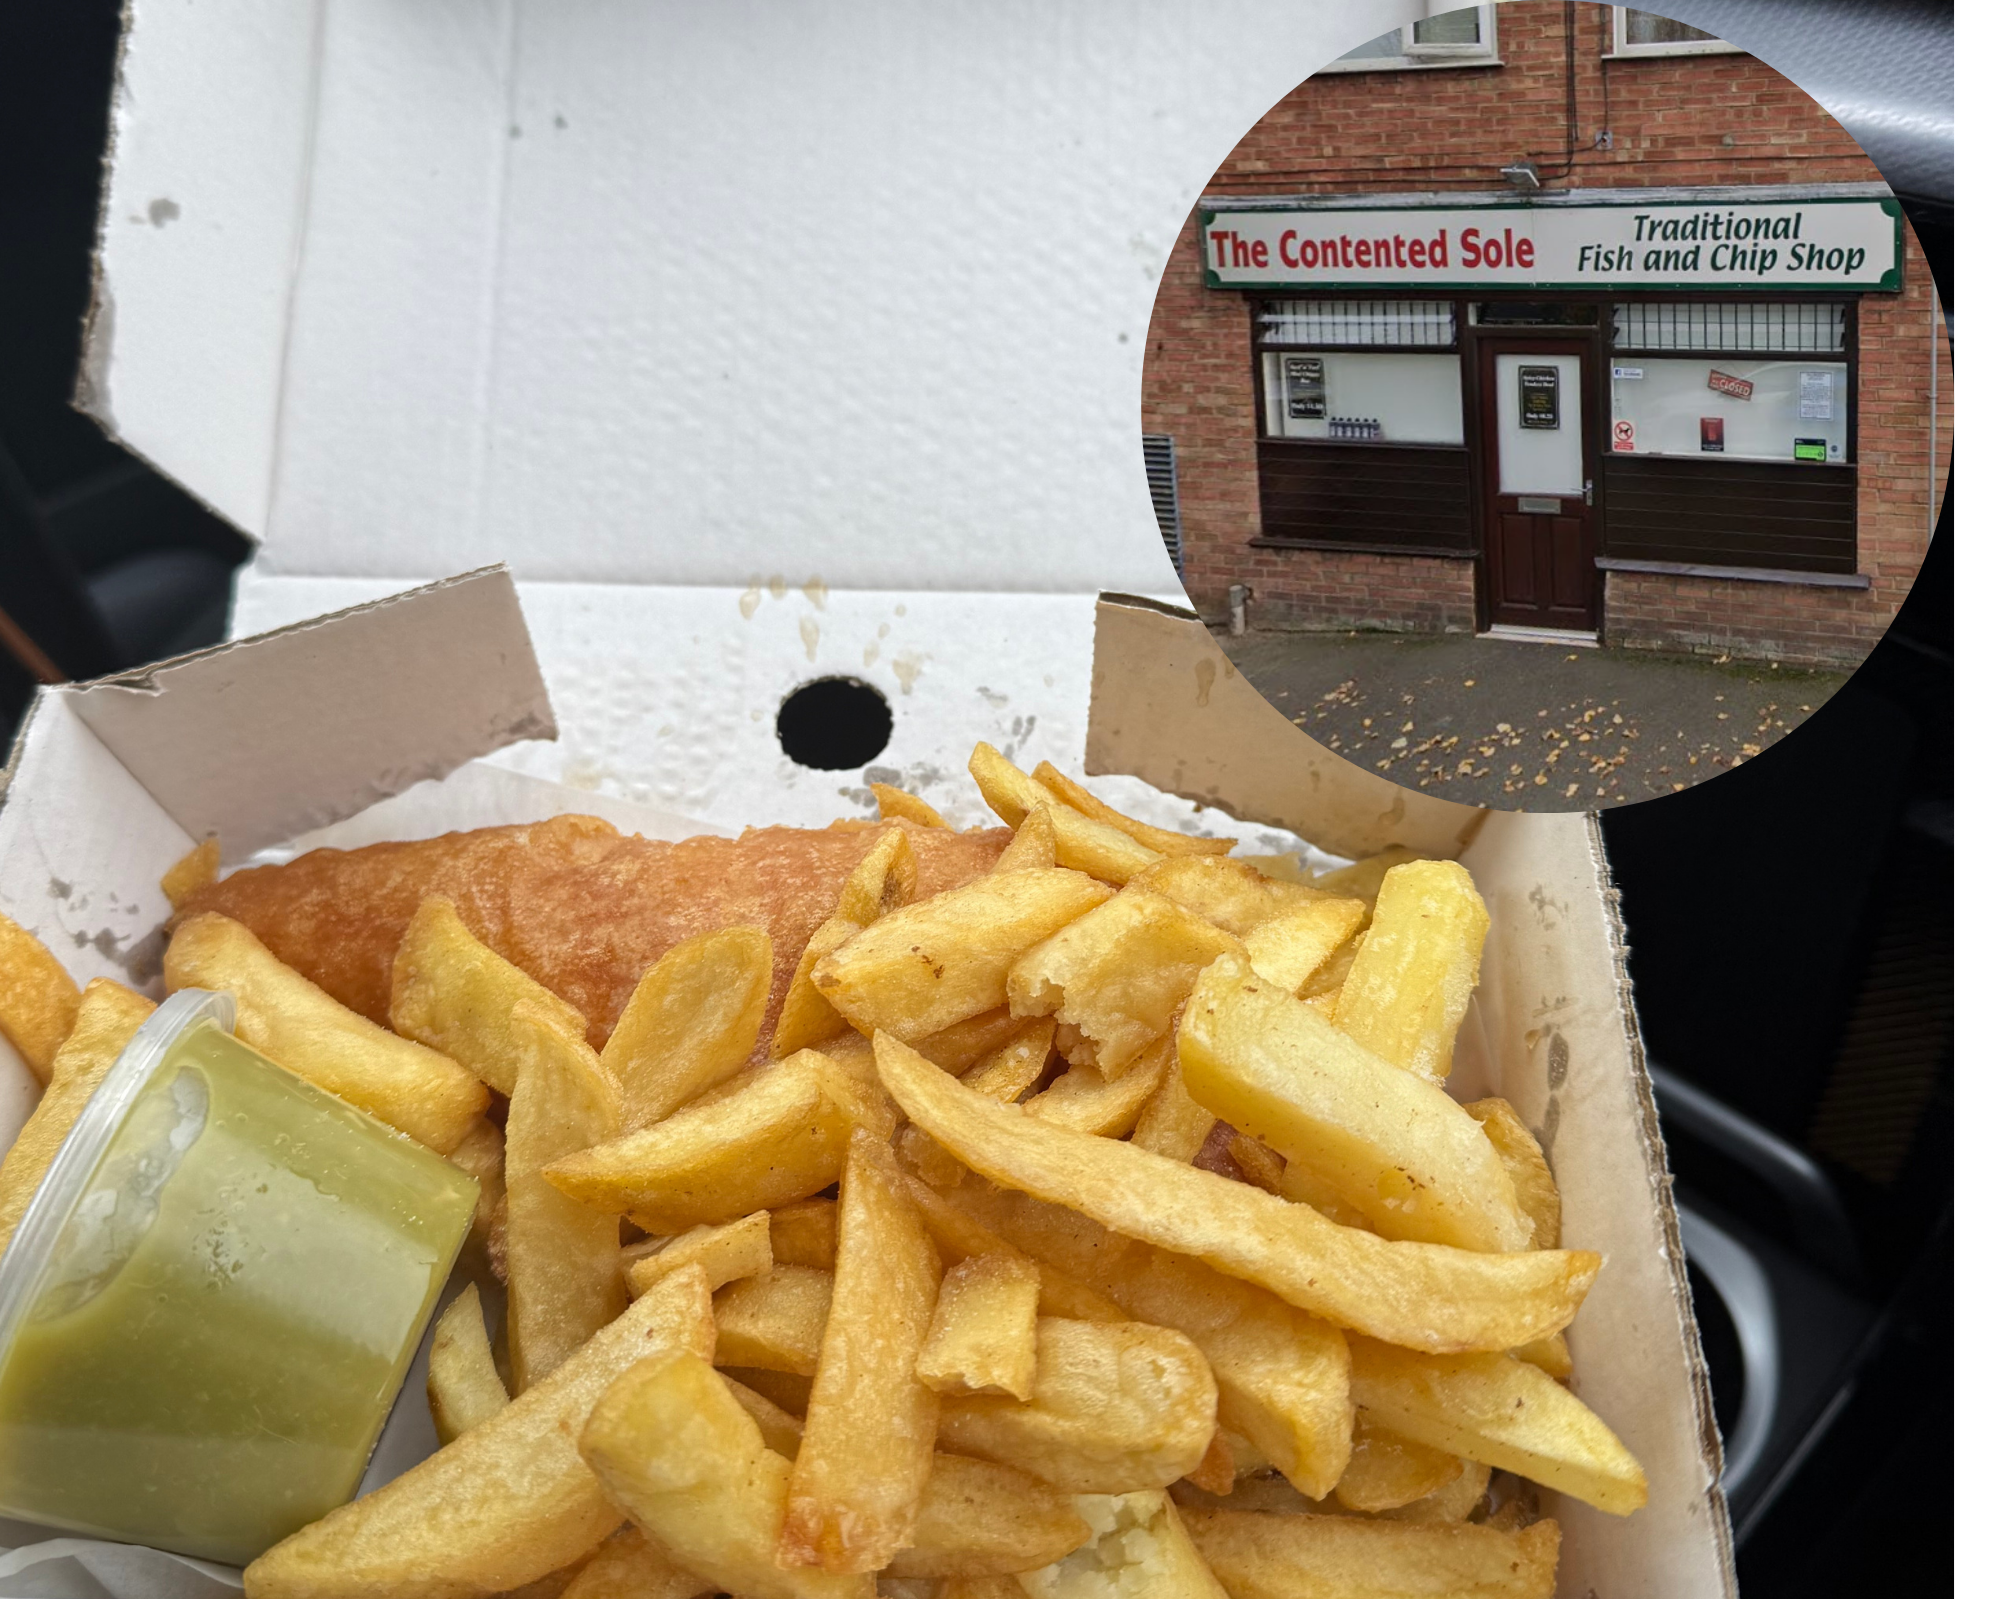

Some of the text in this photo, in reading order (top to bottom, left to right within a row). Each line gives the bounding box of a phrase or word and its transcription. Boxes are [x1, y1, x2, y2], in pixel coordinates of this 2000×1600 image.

[1634, 212, 1801, 241] Traditional
[1210, 228, 1535, 269] The Contented Sole
[1578, 242, 1866, 275] Fish and Chip Shop
[1720, 379, 1750, 396] CLOSED
